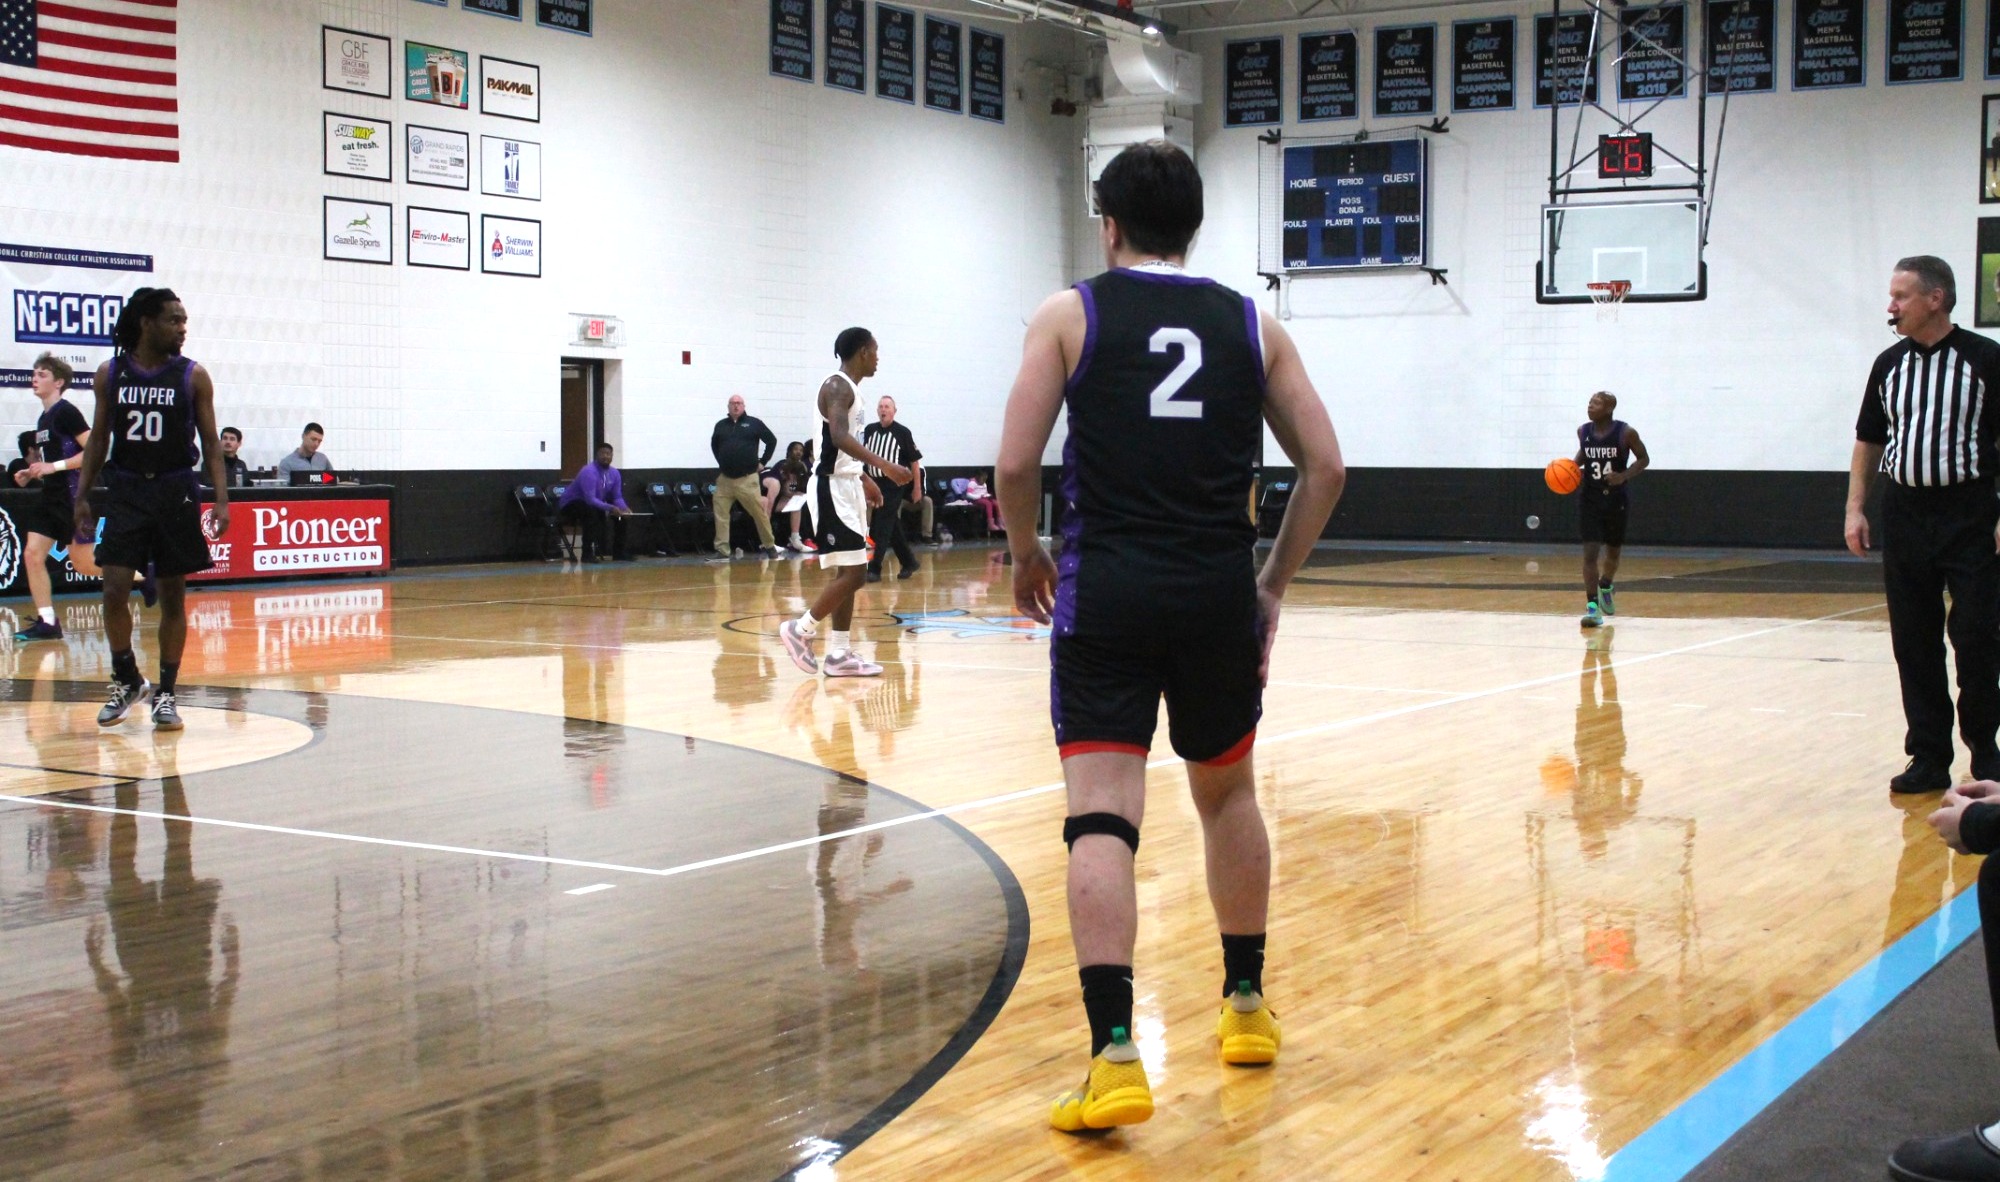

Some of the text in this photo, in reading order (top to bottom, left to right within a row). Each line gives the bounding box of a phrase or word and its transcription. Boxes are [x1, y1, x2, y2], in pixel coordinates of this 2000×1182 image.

[1817, 25, 1841, 33] MEN'S
[1905, 18, 1945, 28] WOMEN'S
[1908, 28, 1942, 38] SOCCER
[1803, 34, 1855, 45] BASKETBALL
[341, 39, 369, 59] GBF
[1803, 46, 1856, 58] NATIONAL
[1473, 52, 1493, 60] MEN'S
[1317, 64, 1337, 72] MEN'S
[1461, 61, 1505, 70] BASKETBALL
[1627, 59, 1677, 71] NATIONAL
[1307, 72, 1348, 81] BASKETBALL
[1383, 67, 1426, 76] BASKETBALL
[487, 77, 534, 96] PAKMAIL
[1233, 79, 1273, 88] BASKETBALL
[1382, 77, 1428, 88] NATIONAL
[1637, 83, 1668, 96] 2015
[335, 124, 376, 140] SUBWAY
[342, 143, 355, 151] eat
[1290, 173, 1416, 188] HOME PERIOD GUEST
[1340, 197, 1361, 205] POSS
[1338, 206, 1364, 214] BONUS
[1283, 214, 1420, 228] FOULS PLAYER FOUL FOULS
[333, 235, 381, 249] Gazelle Sports
[411, 229, 466, 243] Enviro-Master
[505, 235, 534, 247] SHERWIN
[20, 249, 53, 260] CHRISTIAN
[54, 252, 79, 262] COLLEGE
[80, 255, 109, 264] ATHLETIC
[110, 257, 147, 267] ASSOCIATION
[1360, 257, 1382, 265] GAME
[1402, 255, 1420, 263] WON
[17, 293, 121, 336] NCCAA
[591, 320, 605, 336] EXIT
[1149, 327, 1203, 418] 2
[118, 386, 175, 406] KUYPER
[127, 410, 163, 442] 20
[1584, 447, 1617, 458] KUYPER
[1591, 461, 1613, 480] 34
[252, 506, 382, 546] Pioneer
[259, 551, 378, 565] CONSTRUCTION
